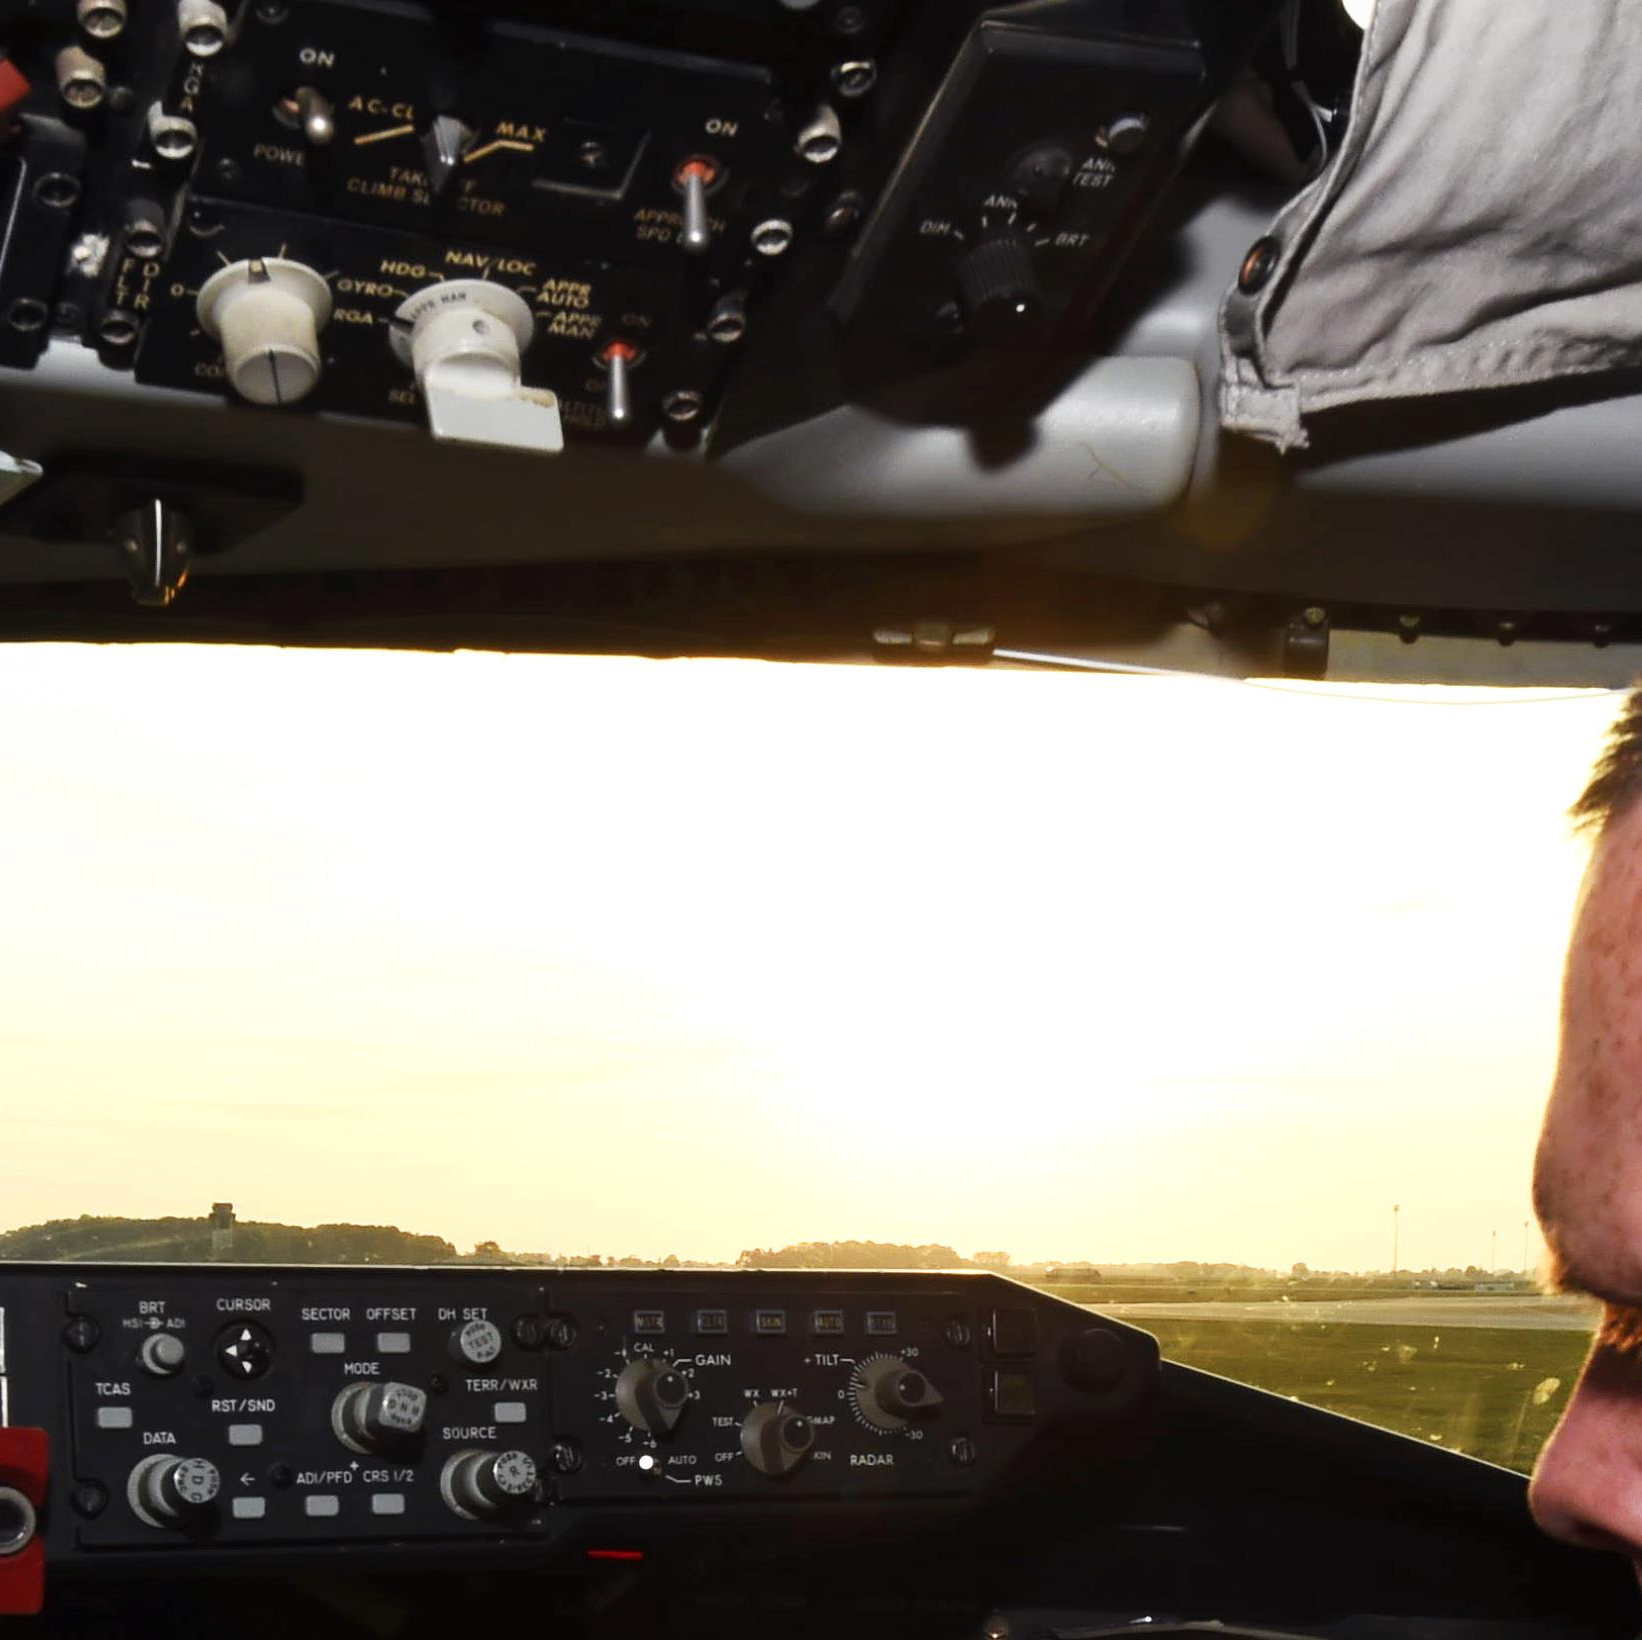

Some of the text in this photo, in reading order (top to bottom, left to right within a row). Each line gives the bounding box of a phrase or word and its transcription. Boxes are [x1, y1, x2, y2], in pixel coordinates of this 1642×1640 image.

[299, 48, 336, 69] ON
[494, 119, 547, 143] MAX
[705, 117, 739, 138] ON
[919, 221, 951, 236] DIM
[379, 259, 431, 280] HDG
[445, 250, 538, 278] NAV/LOC
[114, 257, 136, 306] FLT
[133, 262, 160, 309] DIR
[337, 278, 394, 299] GYRO
[540, 278, 592, 299] APPR
[538, 290, 591, 310] AUTO
[332, 307, 375, 326] RGA
[551, 310, 603, 331] APPR
[548, 322, 596, 341] MAN
[139, 1301, 165, 1314] BRT
[216, 1298, 271, 1312] CURSOR
[301, 1308, 488, 1320] SECTOR OFFSET DH SET
[633, 1342, 654, 1353] CAL
[695, 1353, 732, 1367] GAIN
[815, 1354, 840, 1366] TILT
[344, 1362, 381, 1375] MODE
[95, 1382, 131, 1395] TCAS
[465, 1379, 538, 1392] TERR/WXR
[212, 1399, 275, 1412] RST/SND
[712, 1416, 734, 1427] TEST
[143, 1432, 177, 1445] DATA
[442, 1427, 497, 1440] SOURCE
[615, 1454, 698, 1467] OFF AUTO
[714, 1451, 735, 1462] OFF
[850, 1454, 894, 1467] RADAR
[296, 1470, 414, 1484] ADI/PFD CRS 1/2
[695, 1474, 723, 1486] PWS
